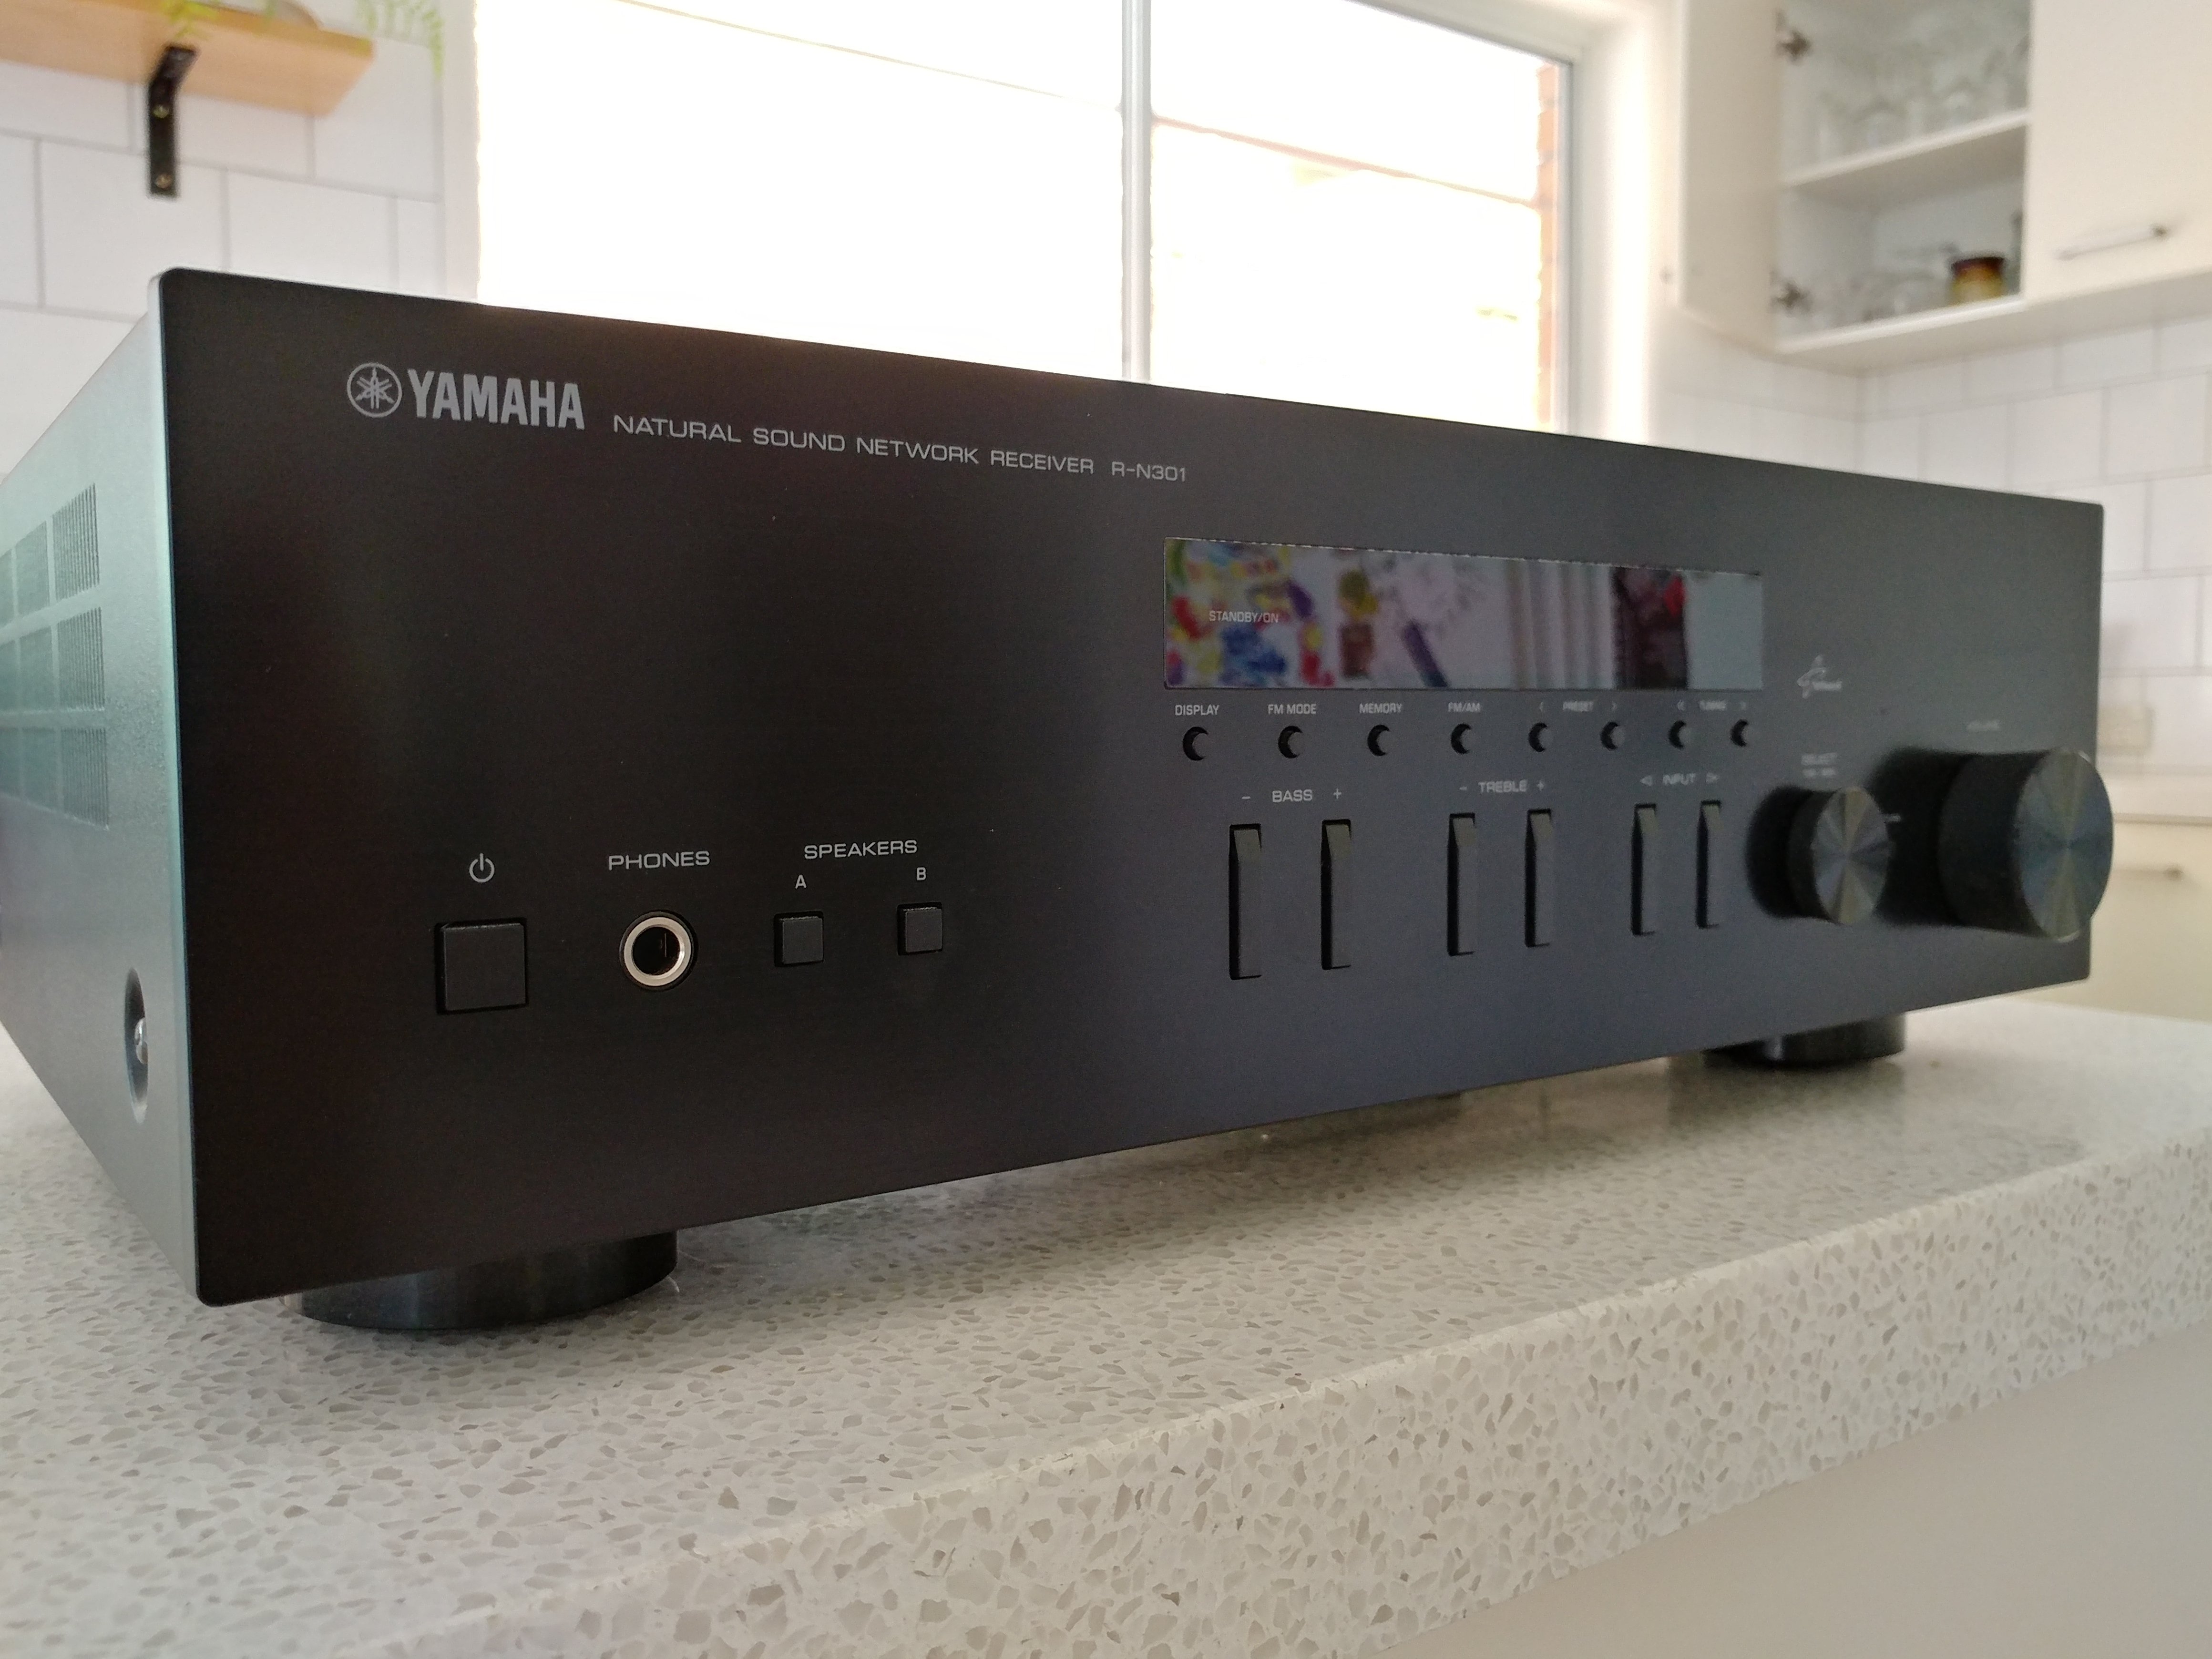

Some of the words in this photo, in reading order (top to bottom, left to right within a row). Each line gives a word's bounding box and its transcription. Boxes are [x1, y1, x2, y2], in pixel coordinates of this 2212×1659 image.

[407, 369, 585, 430] YAMAHA
[613, 415, 741, 443] NATURAL
[753, 428, 845, 452] SOUND
[857, 437, 979, 464] NETWORK
[991, 450, 1094, 474] RECEIVER
[1112, 461, 1186, 482] R-N301
[1208, 610, 1279, 624] STANDBY/ON
[1175, 704, 1219, 716] DISPLAY
[1268, 703, 1284, 715] FM
[1286, 703, 1317, 715] MODE
[1359, 703, 1403, 714] MEMORY
[1447, 702, 1481, 713] FM/AM
[1478, 779, 1527, 793] TREBLE
[1662, 773, 1696, 785] INPUT
[1272, 789, 1313, 803] BASS
[804, 839, 918, 860] SPEAKERS
[608, 850, 710, 871] PHONES
[916, 867, 927, 881] B
[795, 874, 807, 889] A
